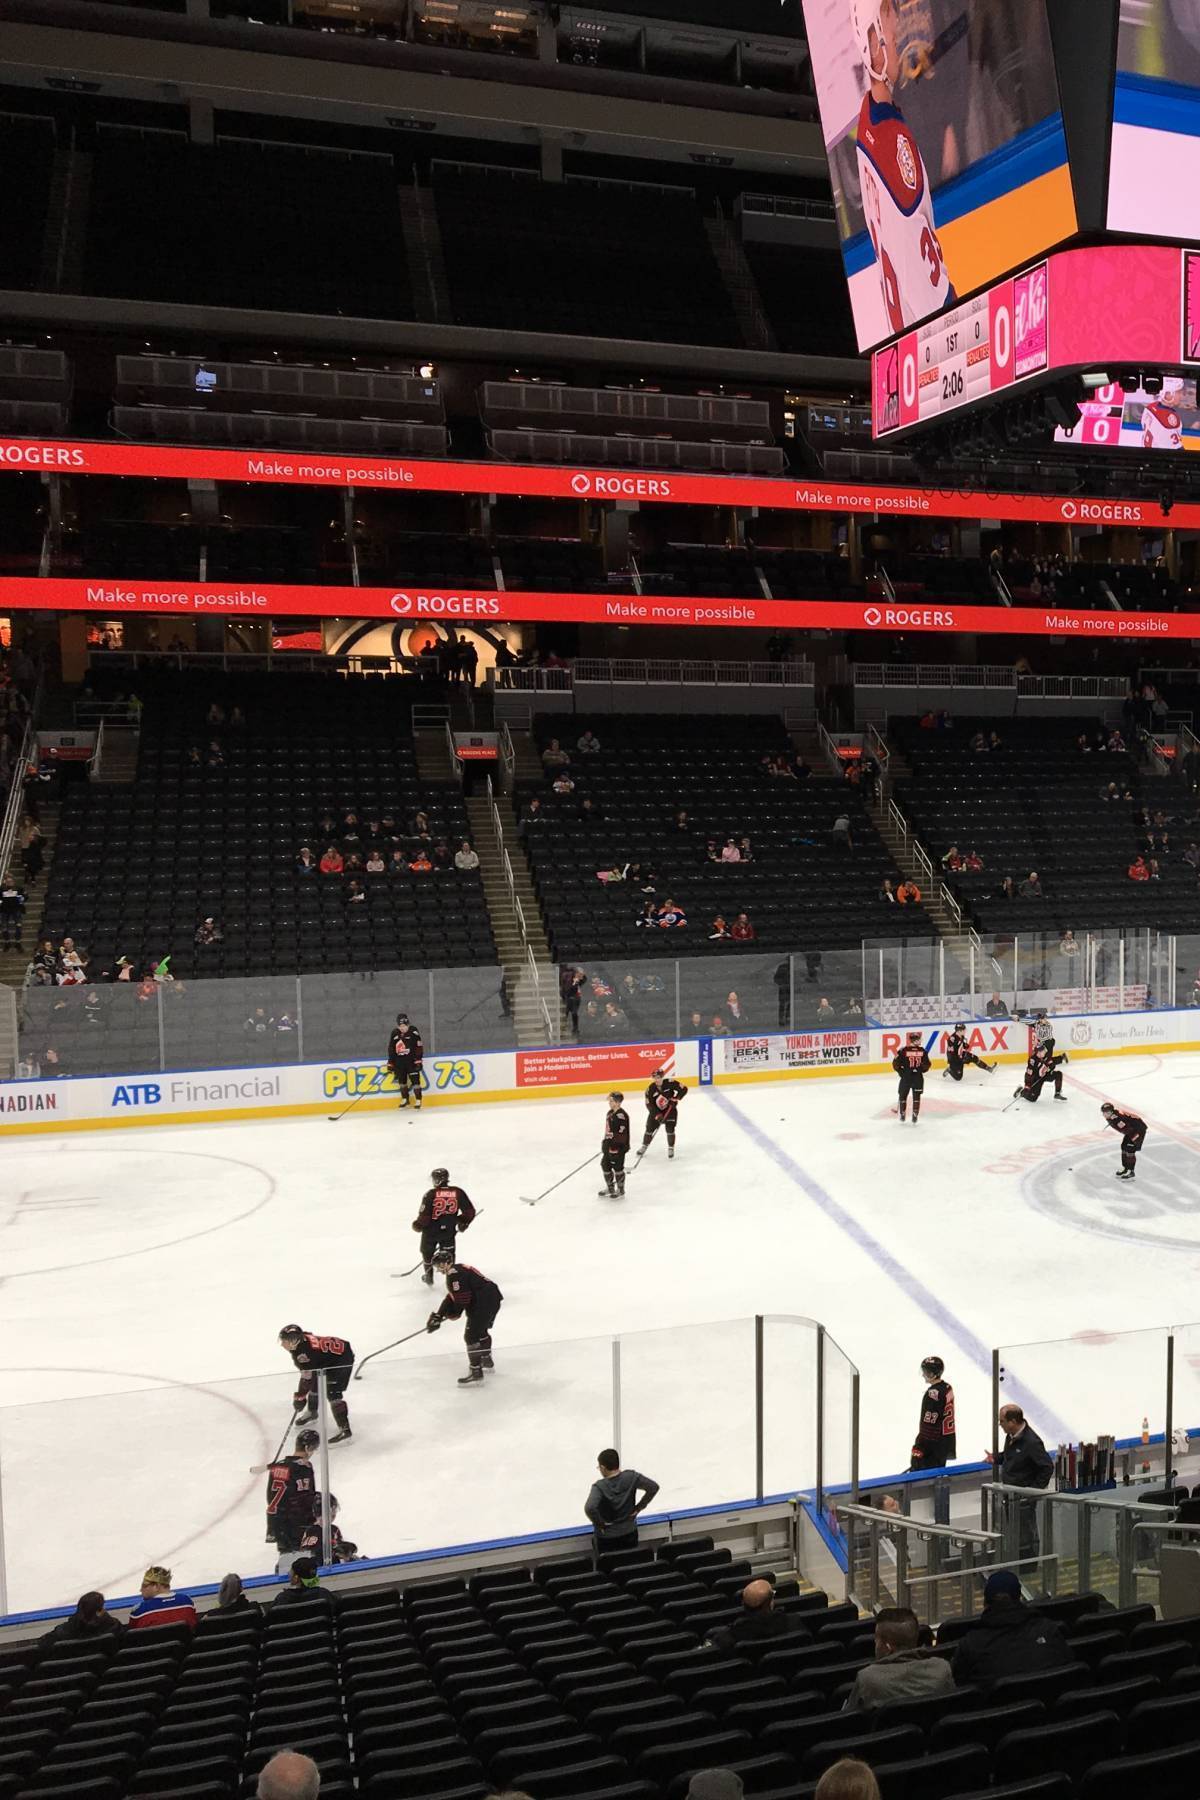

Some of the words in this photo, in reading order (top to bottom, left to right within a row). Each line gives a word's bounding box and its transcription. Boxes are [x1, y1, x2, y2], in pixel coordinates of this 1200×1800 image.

[903, 353, 915, 407] 0
[946, 332, 959, 353] 1ST
[994, 306, 1010, 368] 0
[942, 371, 963, 400] 2:06
[246, 459, 294, 477] Make
[298, 466, 341, 478] more
[346, 467, 414, 482] possible
[595, 476, 670, 496] ROGERS
[796, 490, 833, 504] Make
[836, 495, 871, 506] more
[875, 495, 930, 510] possible
[1080, 504, 1141, 521] ROGERS
[87, 587, 137, 603] Make
[142, 593, 189, 604] more
[194, 591, 267, 608] possible
[417, 596, 500, 614] ROGERS
[606, 602, 647, 616] Make
[652, 607, 691, 618] more
[694, 605, 755, 621] possible
[885, 609, 954, 626] ROGERS
[1045, 615, 1080, 629] Make
[1083, 620, 1115, 630] more
[1118, 618, 1169, 633] possible
[785, 1034, 812, 1049] YUKON
[823, 1032, 858, 1047] MCCORD
[524, 1057, 546, 1065] Better
[588, 1053, 610, 1061] Better
[644, 1049, 667, 1059] CLAC
[736, 1047, 769, 1056] BEAR
[780, 1052, 795, 1060] THE
[822, 1046, 861, 1059] WORST
[789, 1059, 816, 1067] MORNING
[434, 1059, 475, 1090] 73
[111, 1083, 161, 1107] ATB
[171, 1076, 280, 1103] Financial
